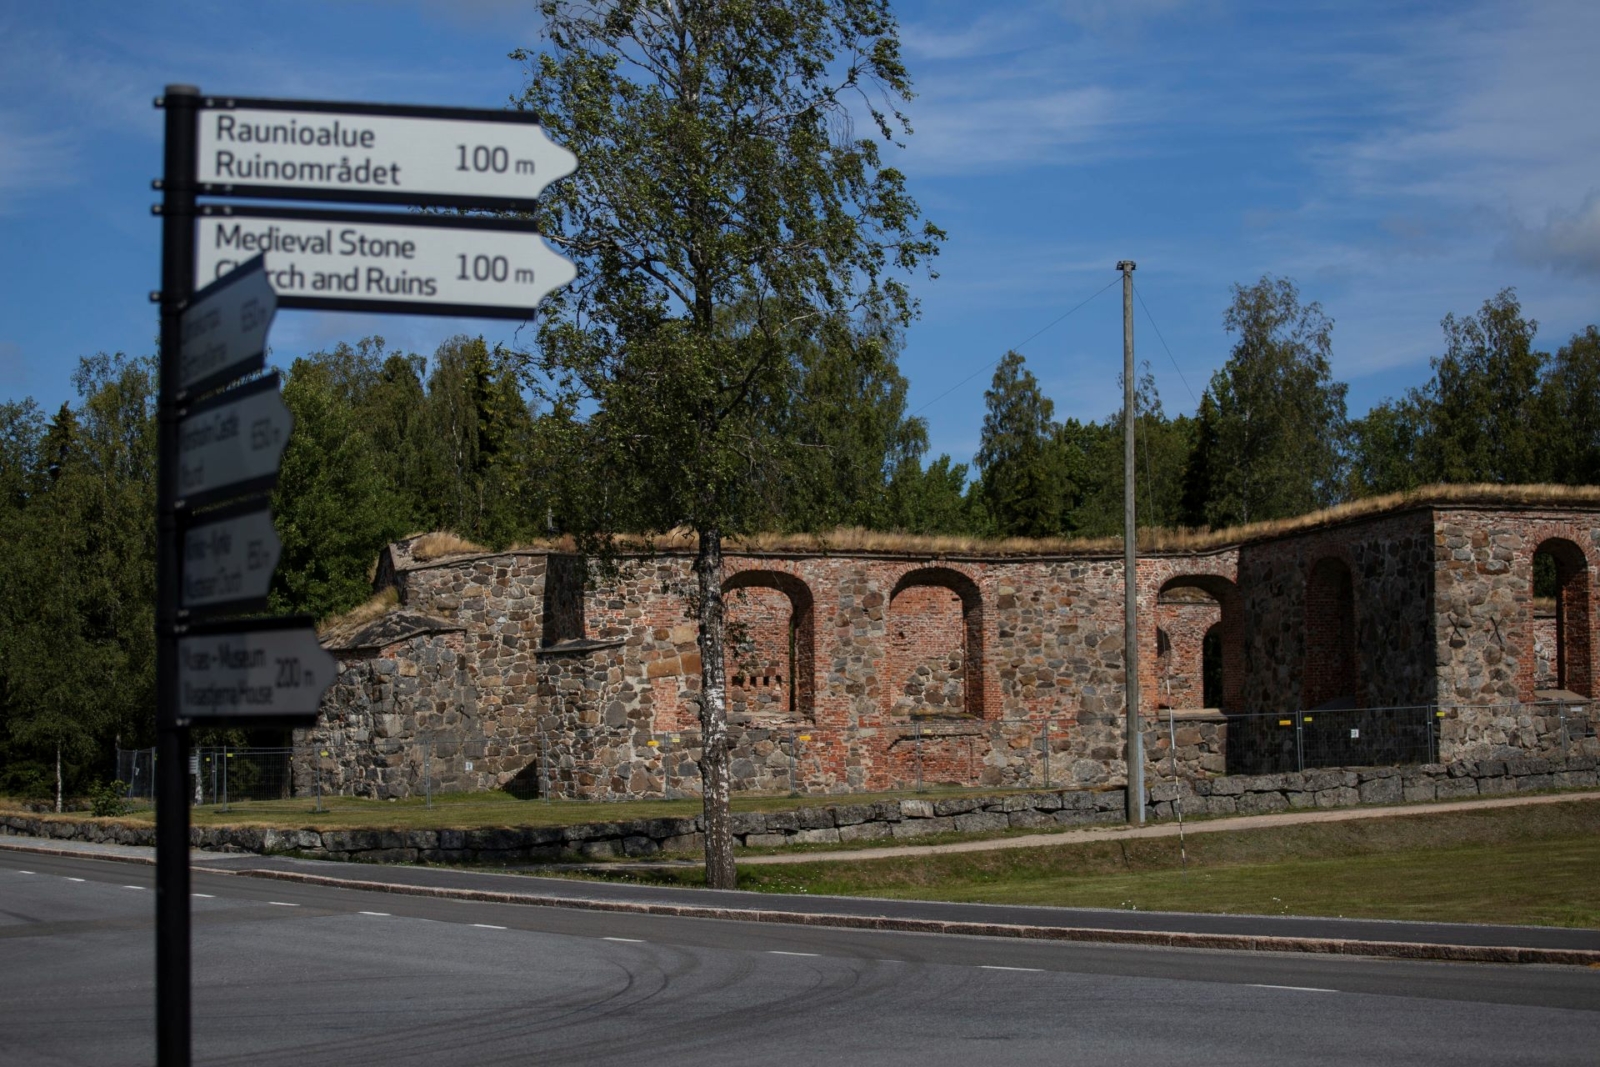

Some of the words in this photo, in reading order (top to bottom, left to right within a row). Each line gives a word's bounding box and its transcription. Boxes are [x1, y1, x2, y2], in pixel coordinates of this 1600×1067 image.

[216, 115, 376, 149] Raunioalue
[215, 150, 401, 186] Ruinområdet
[457, 144, 509, 174] 100
[515, 159, 536, 175] m
[215, 223, 333, 256] Medieval
[339, 229, 416, 260] Stone
[215, 259, 306, 290] Crch
[311, 266, 360, 293] and
[366, 268, 438, 297] Ruins
[457, 253, 509, 284] 100
[515, 268, 535, 284] m
